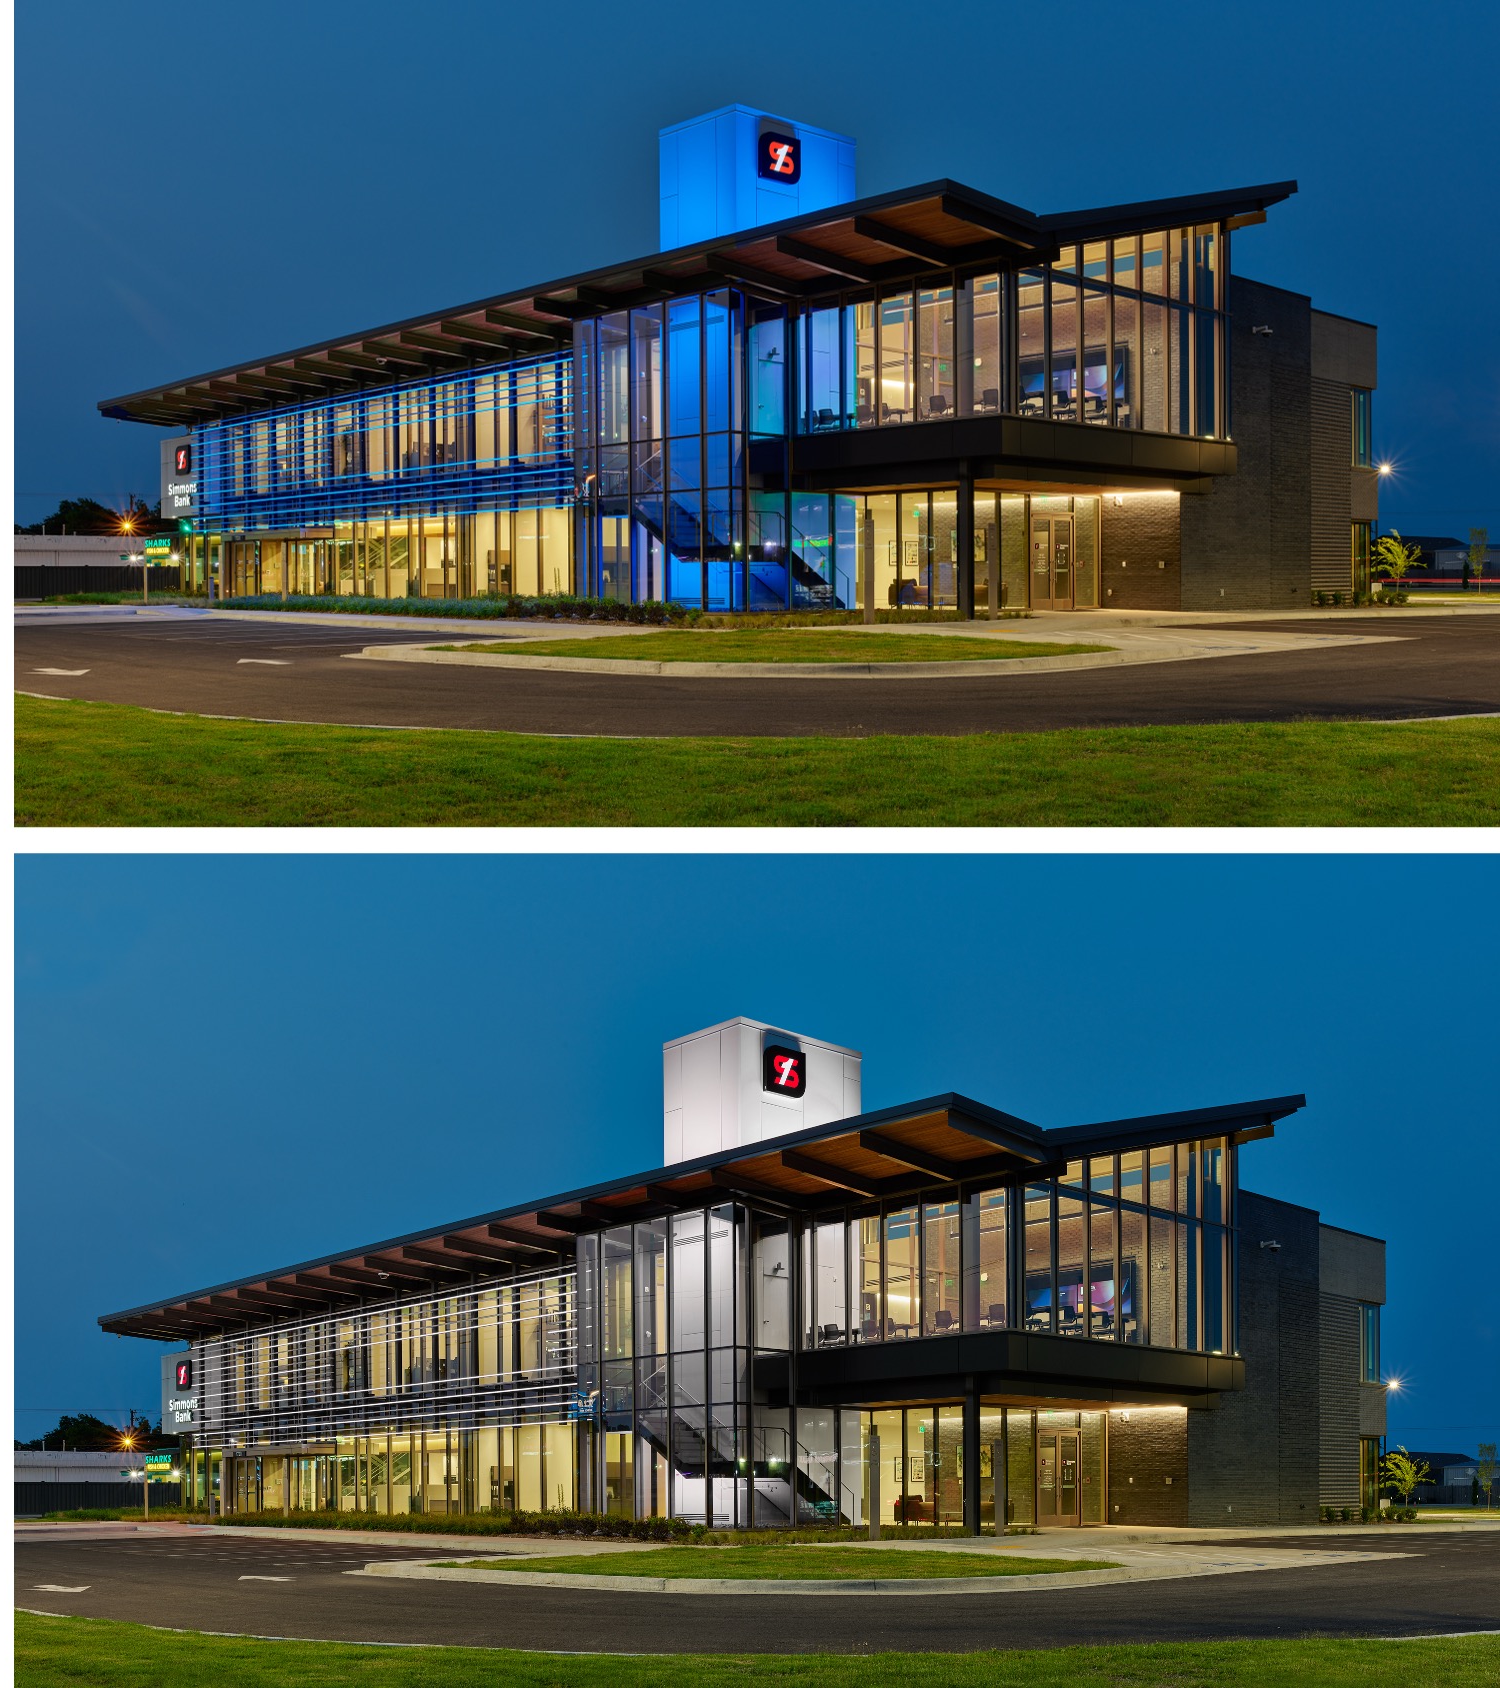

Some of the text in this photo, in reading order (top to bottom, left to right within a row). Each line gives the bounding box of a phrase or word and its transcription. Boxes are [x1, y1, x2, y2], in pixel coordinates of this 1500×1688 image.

[168, 483, 197, 496] Simmons
[174, 495, 191, 507] Bank
[144, 538, 171, 548] SHARKS
[169, 1398, 198, 1411] Simmons
[175, 1410, 192, 1423] Bank
[145, 1454, 171, 1464] SHARKS
